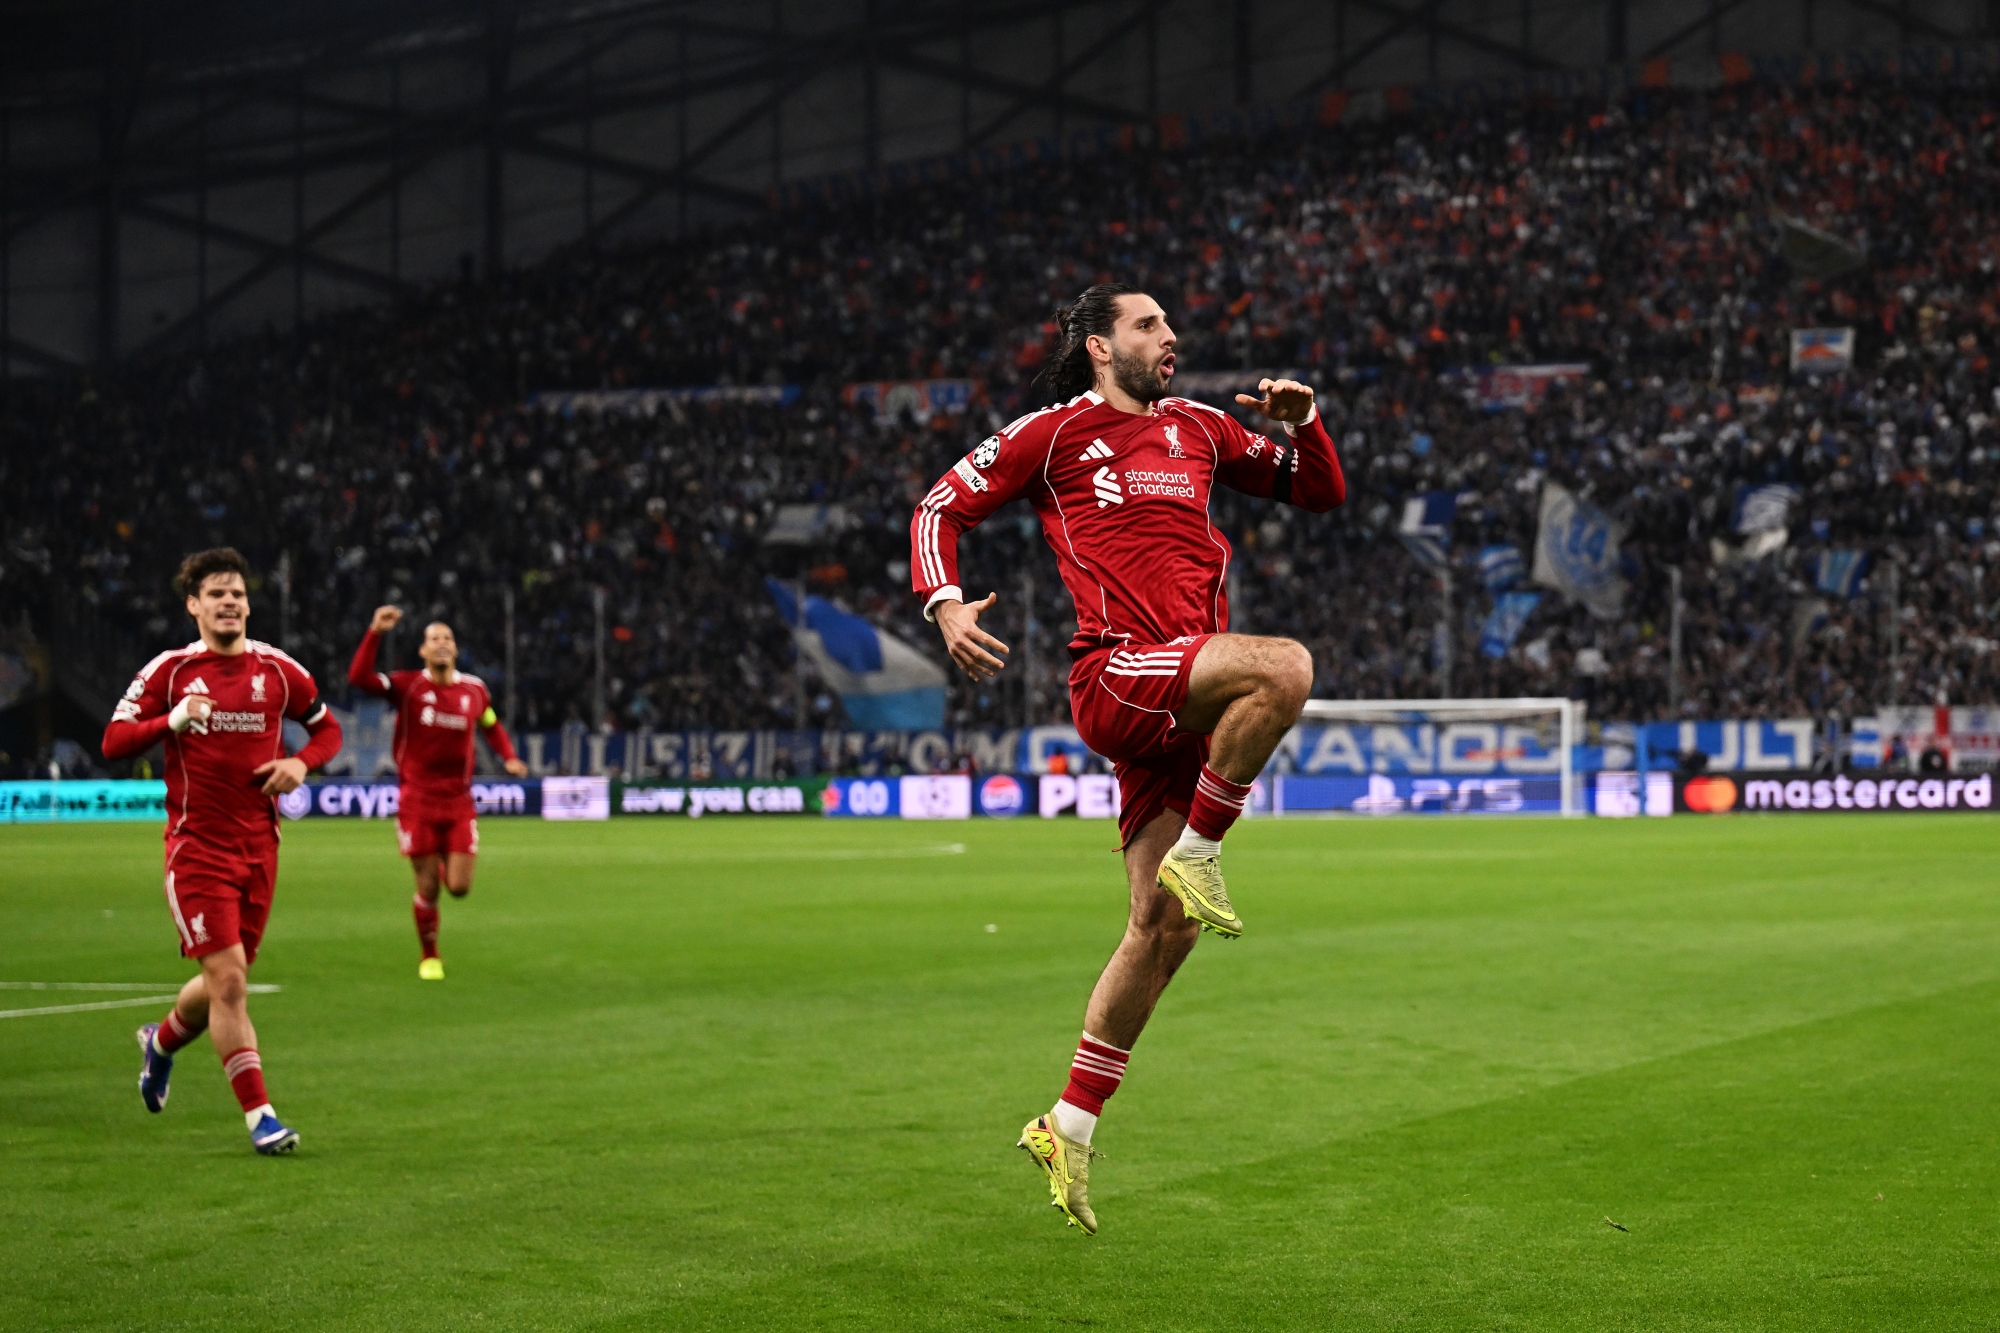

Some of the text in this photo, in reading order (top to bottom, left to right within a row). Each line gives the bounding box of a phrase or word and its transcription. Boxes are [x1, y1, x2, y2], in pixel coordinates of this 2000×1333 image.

[1125, 469, 1189, 484] standard
[1129, 482, 1195, 498] chartered
[211, 710, 265, 723] standard
[211, 720, 266, 733] chartered
[1411, 778, 1524, 813] PS5
[1744, 774, 1992, 810] mastercard
[622, 785, 804, 818] now you can
